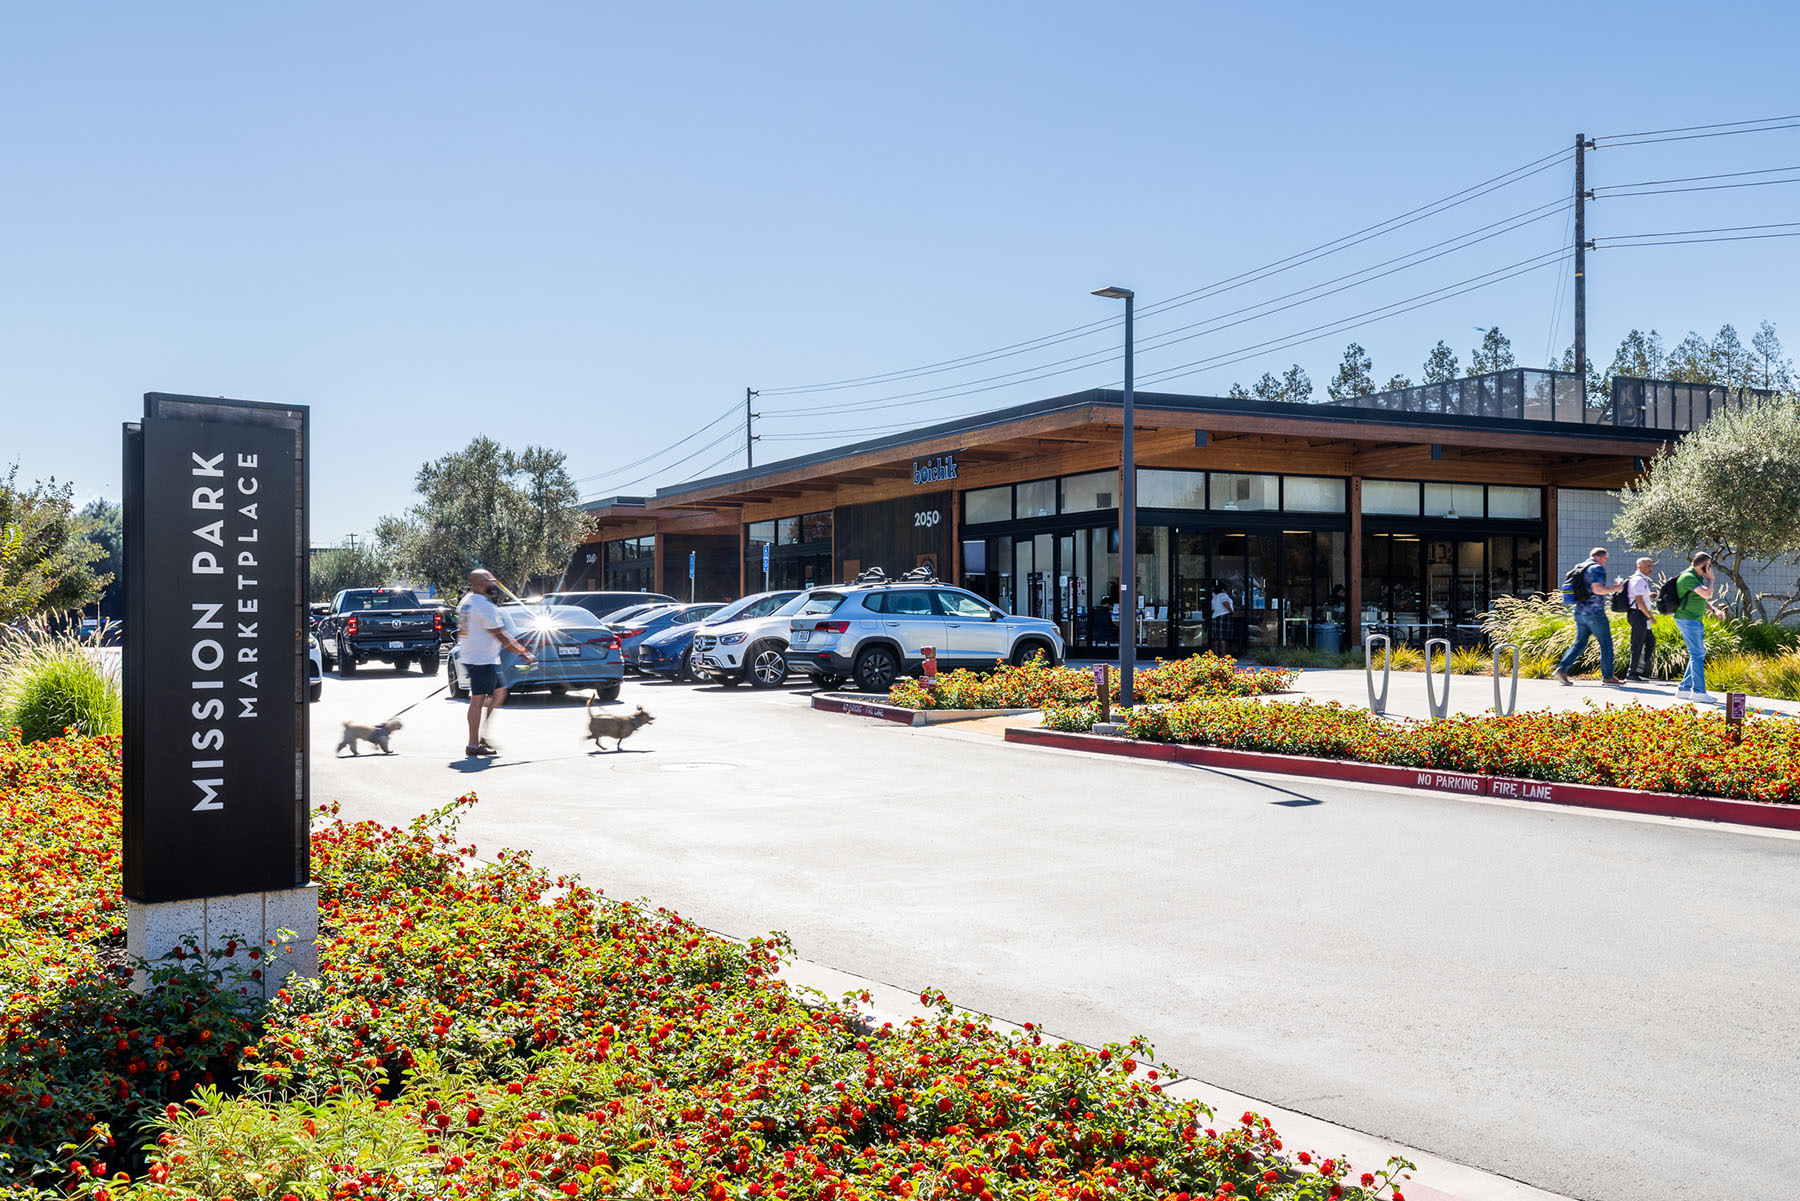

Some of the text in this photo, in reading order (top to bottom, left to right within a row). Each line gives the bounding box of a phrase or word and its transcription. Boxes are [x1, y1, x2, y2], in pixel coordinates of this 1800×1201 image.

[913, 456, 957, 485] boichik
[914, 510, 939, 527] 2050
[237, 453, 259, 718] MARKETPLACE
[191, 451, 225, 812] MISSION PARK
[1417, 773, 1479, 791] NO PARKING
[1492, 781, 1552, 800] FIRE LANE
